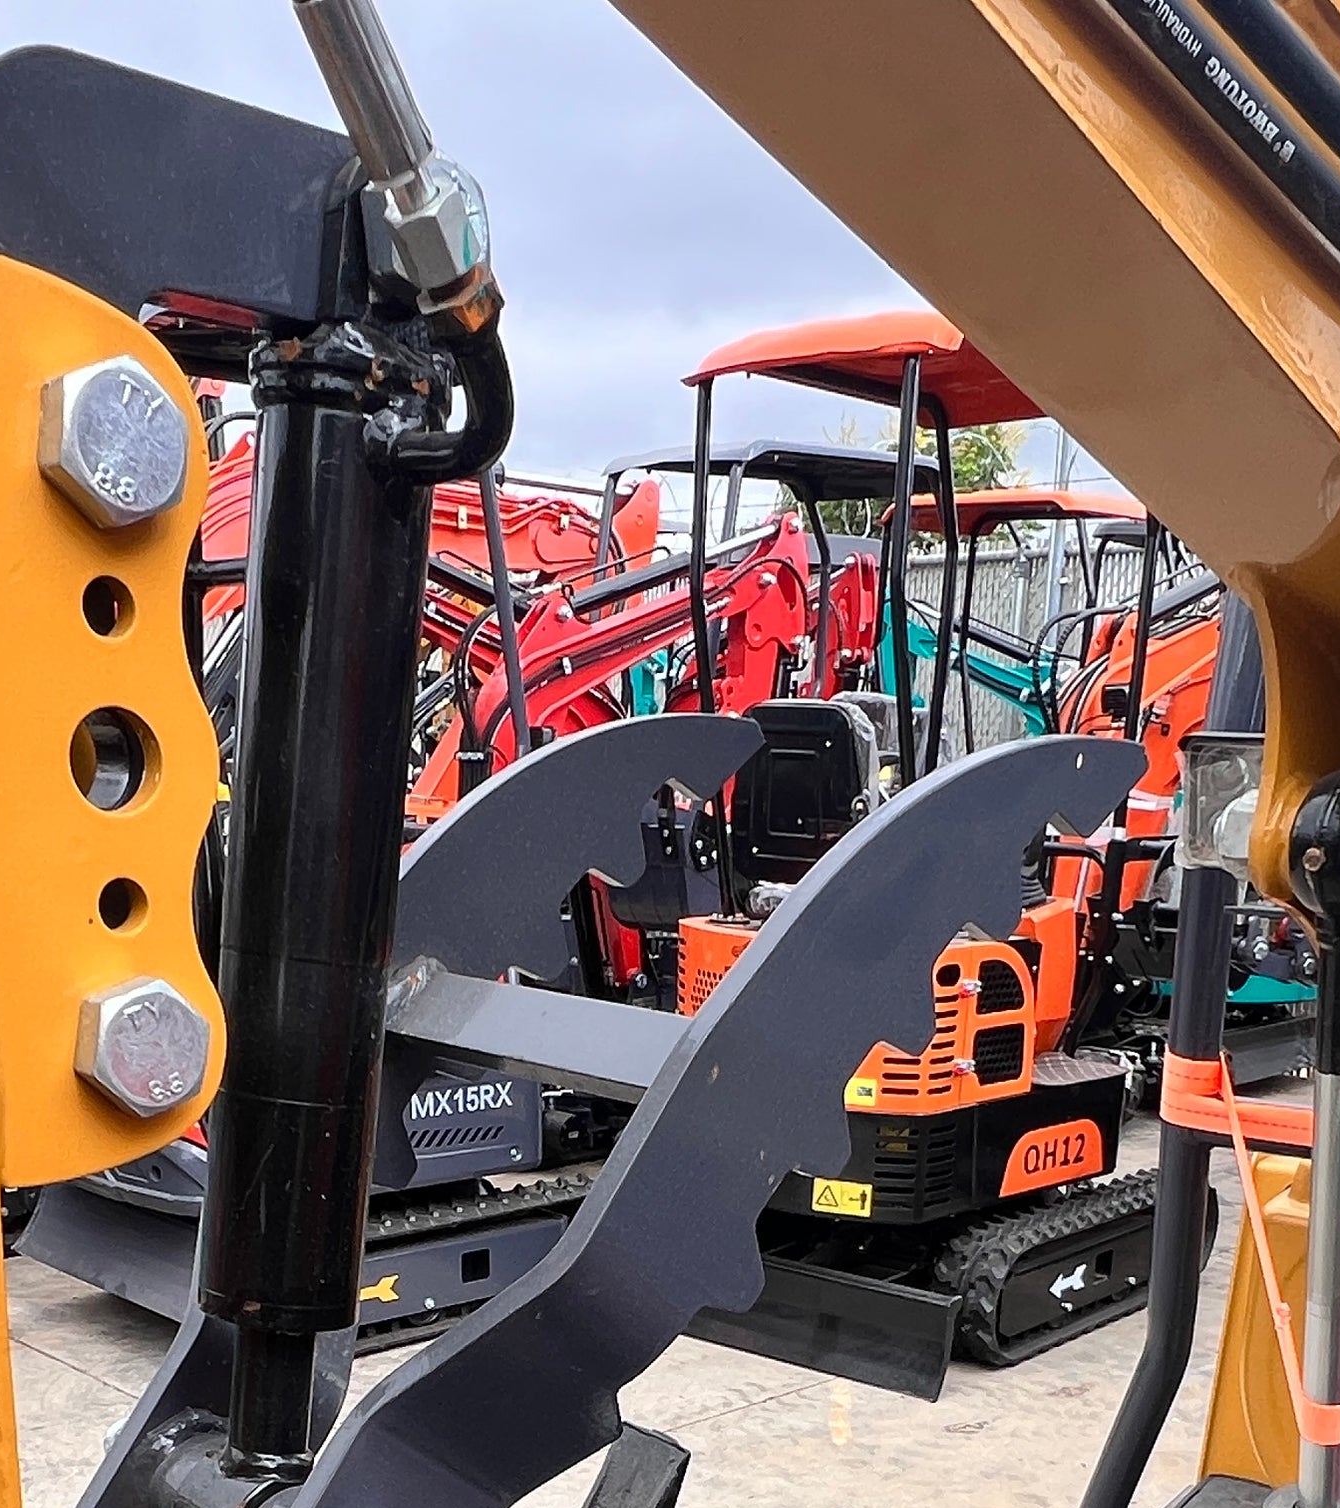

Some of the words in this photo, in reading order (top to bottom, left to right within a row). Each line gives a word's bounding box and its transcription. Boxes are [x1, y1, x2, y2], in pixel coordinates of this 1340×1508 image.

[1142, 0, 1204, 58] HYDRAULI
[411, 1081, 514, 1120] MX15RX
[1024, 1133, 1086, 1175] QH12
